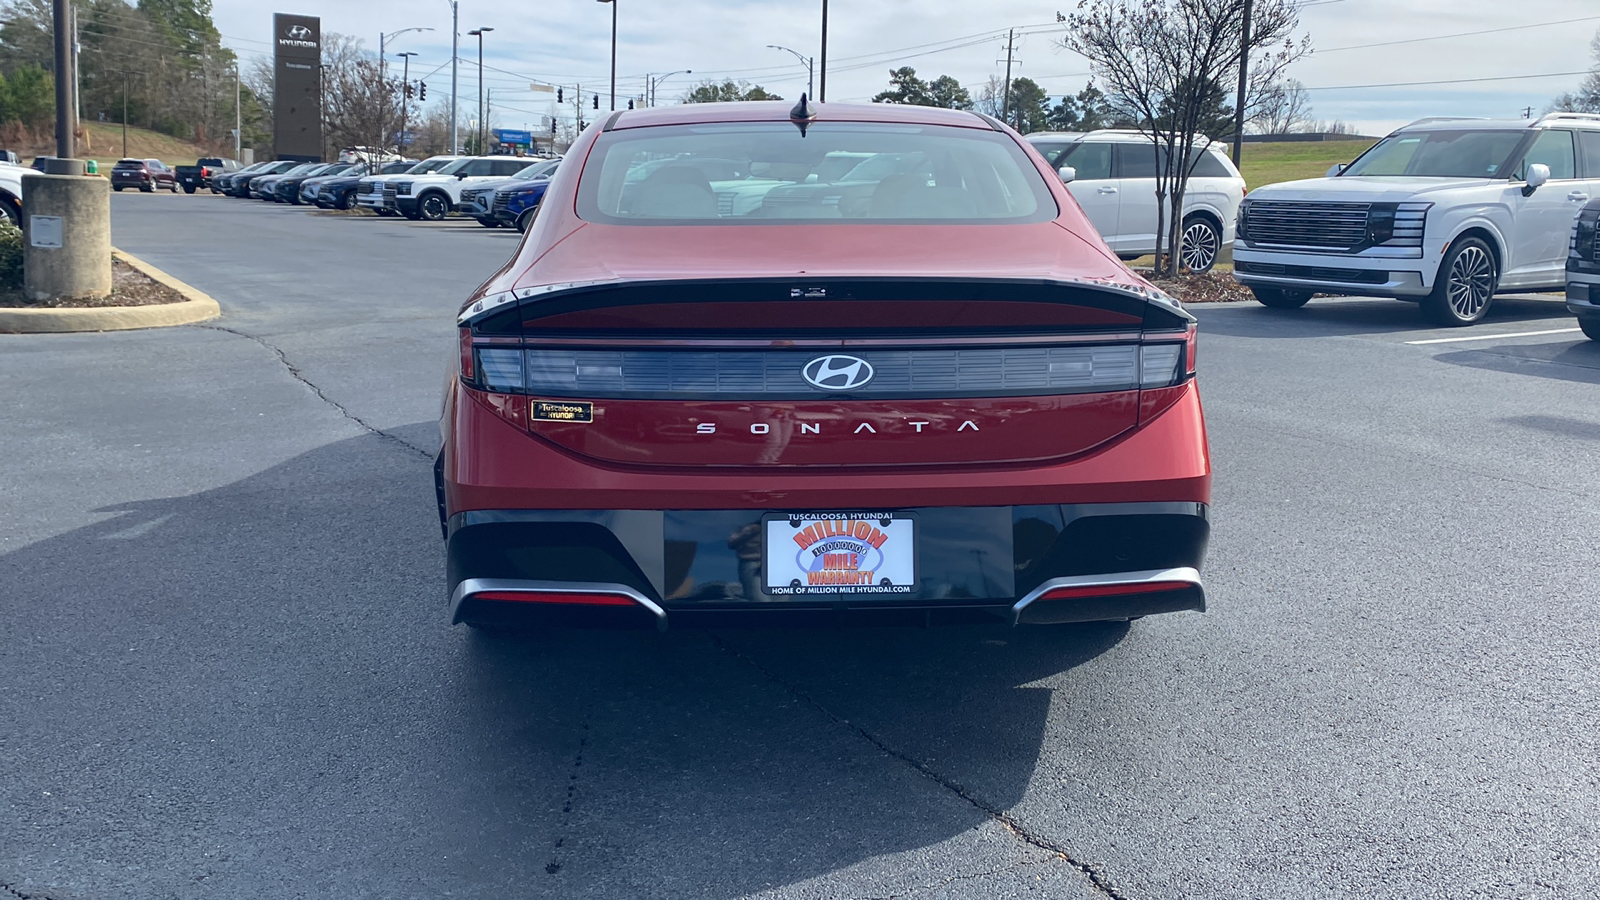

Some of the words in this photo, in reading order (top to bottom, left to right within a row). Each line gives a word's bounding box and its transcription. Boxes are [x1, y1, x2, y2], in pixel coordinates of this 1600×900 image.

[279, 39, 317, 48] HYUNDAI
[541, 403, 583, 413] Tuscaloosa
[696, 420, 980, 434] SONATA
[850, 512, 893, 520] HYUNDAI
[792, 519, 889, 551] MILLION
[823, 553, 858, 570] MILE
[807, 570, 874, 586] WARRANTY
